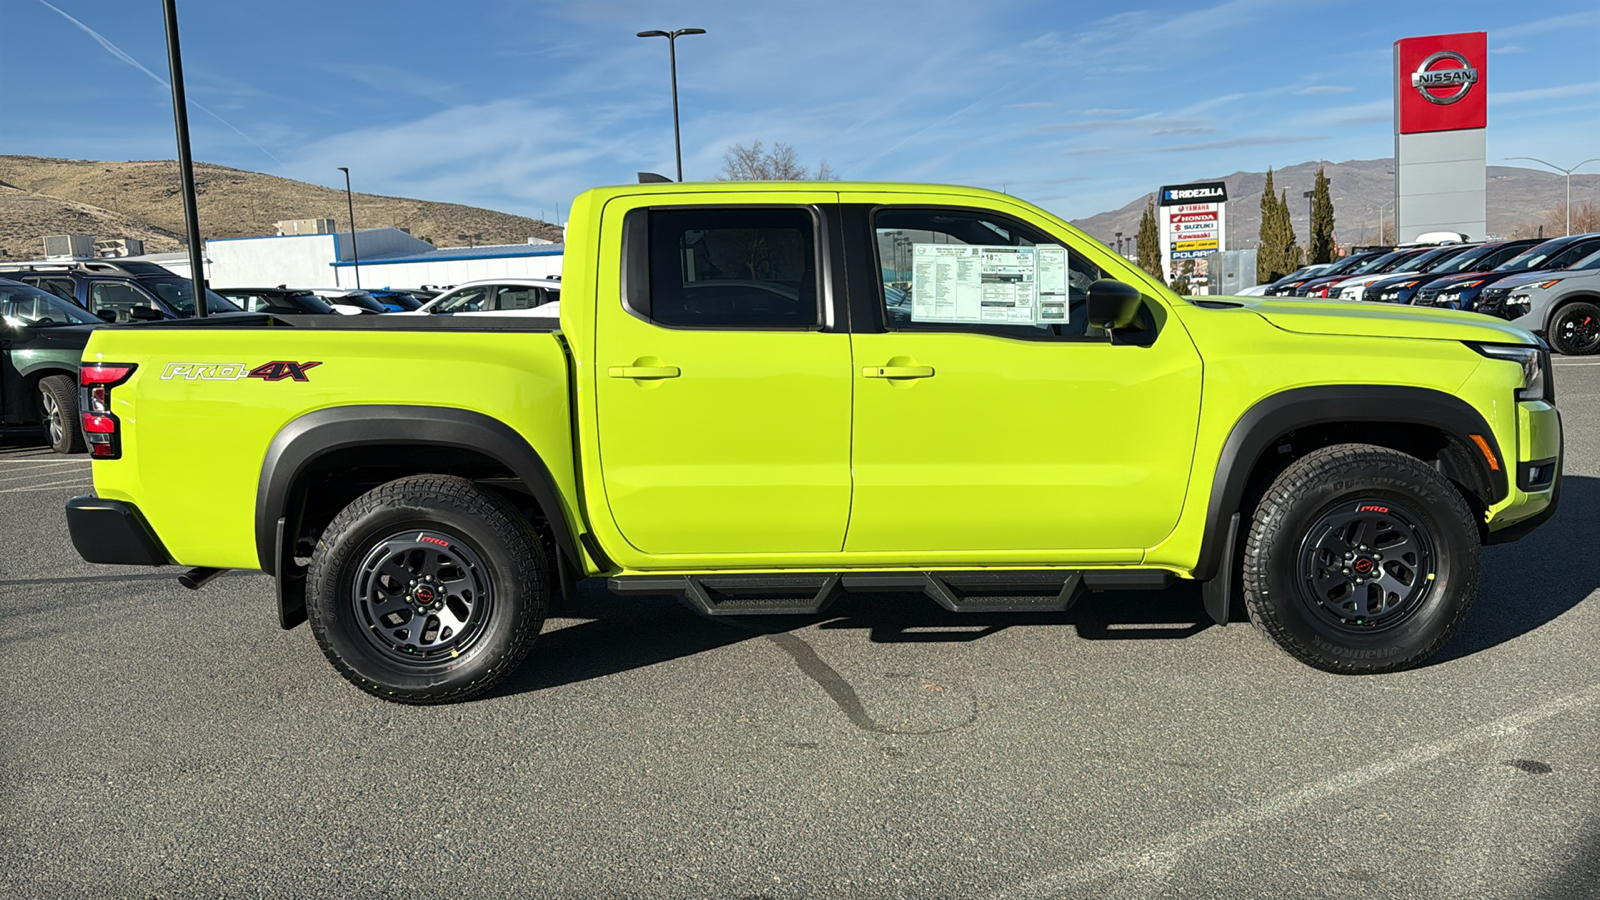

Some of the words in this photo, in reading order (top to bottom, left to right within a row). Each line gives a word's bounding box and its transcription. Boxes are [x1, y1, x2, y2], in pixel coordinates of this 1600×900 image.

[1419, 71, 1471, 83] NISSAN
[1178, 187, 1223, 198] RIDEZILLA
[1177, 232, 1210, 240] Kawasaki
[1360, 505, 1389, 514] PRO
[420, 536, 449, 547] PRO
